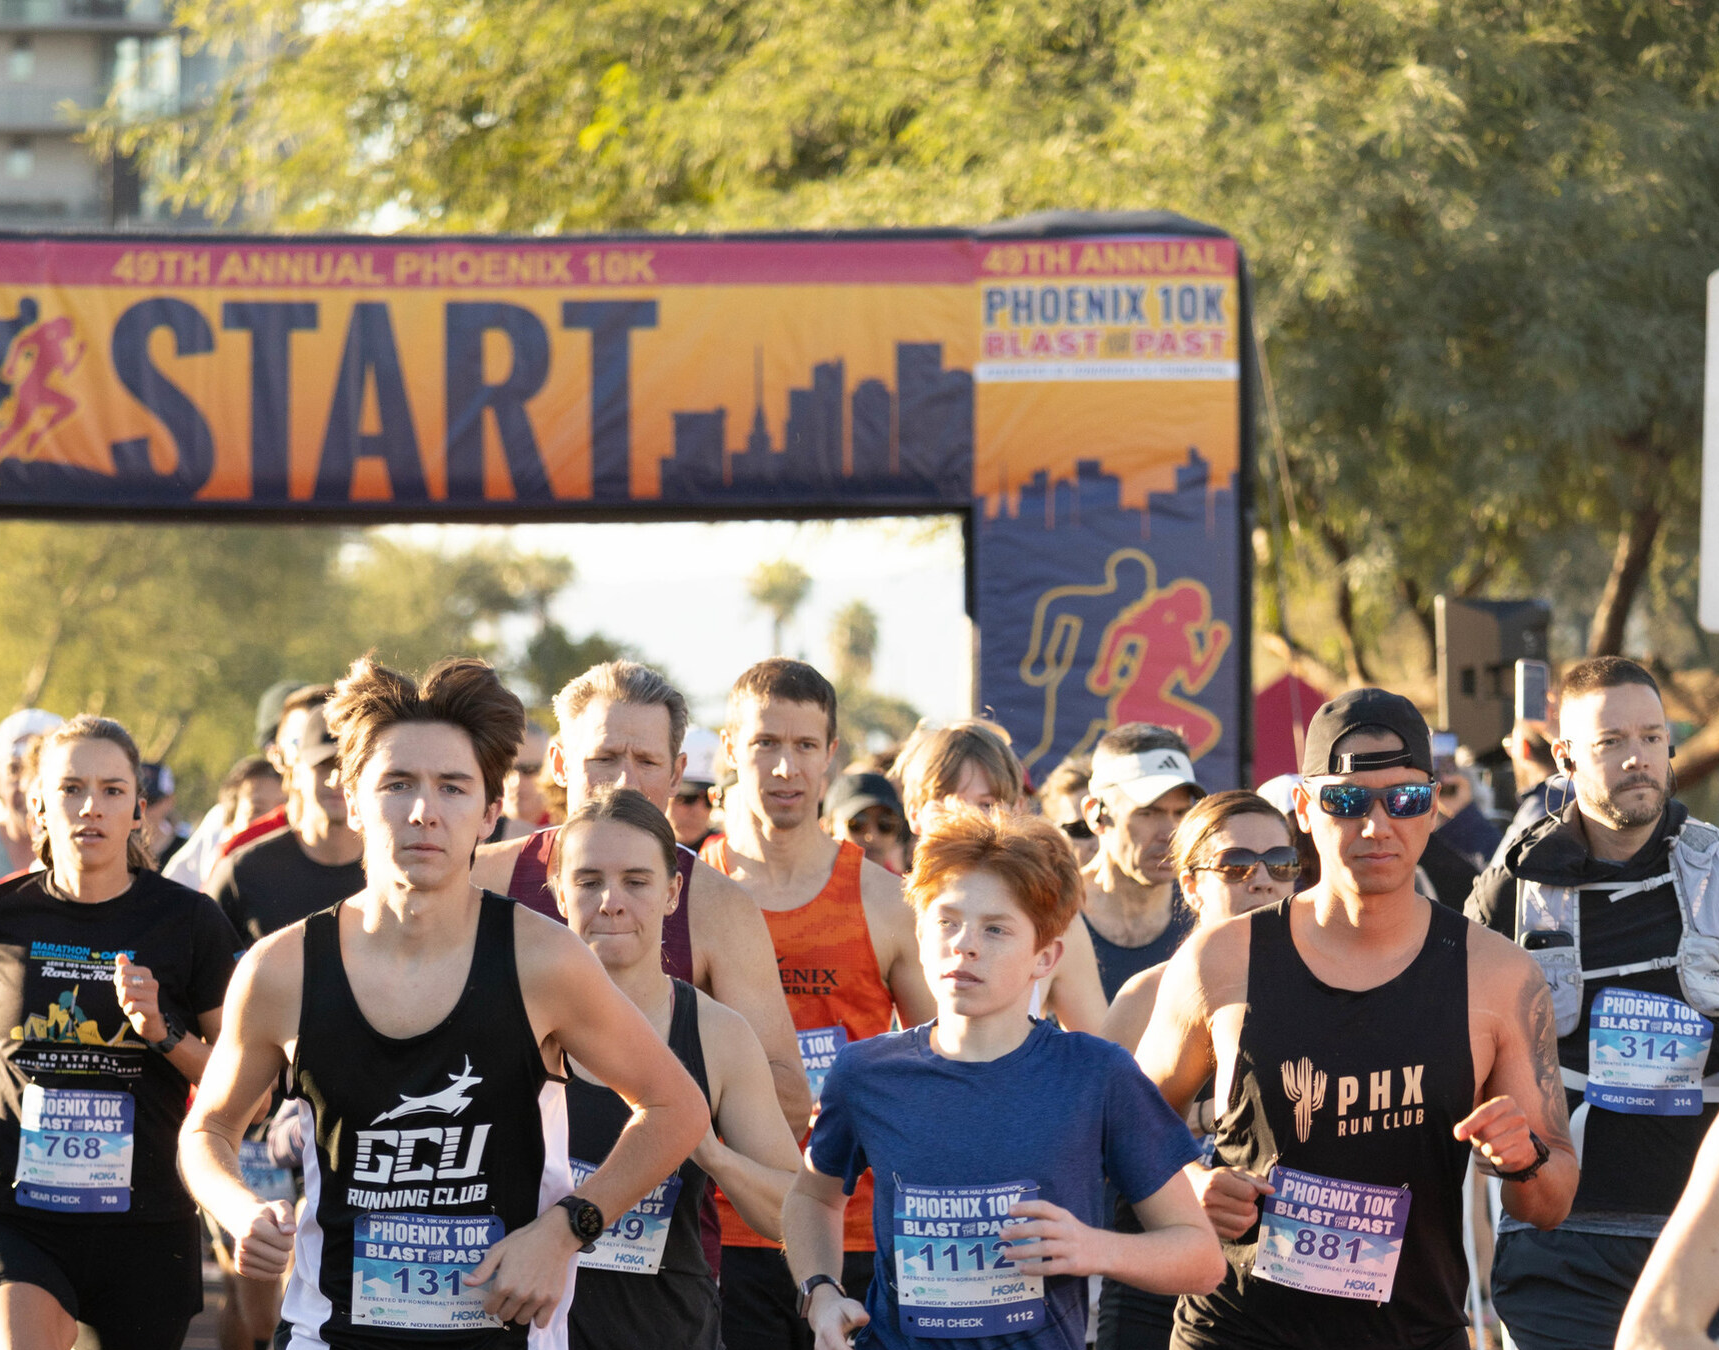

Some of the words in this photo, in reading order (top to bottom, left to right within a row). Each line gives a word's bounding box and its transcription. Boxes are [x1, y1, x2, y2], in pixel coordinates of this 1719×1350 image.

[111, 250, 211, 284] 49TH
[218, 251, 386, 284] ANNUAL
[394, 252, 573, 284] PHOENIX
[585, 251, 657, 283] 10K
[982, 245, 1072, 272] 49TH
[1078, 244, 1225, 271] ANNUAL
[984, 285, 1146, 326] PHOENIX
[1158, 285, 1226, 324] 10K
[986, 331, 1099, 358] BLAST
[1135, 330, 1228, 357] PAST
[111, 297, 659, 501] START
[32, 941, 90, 956] MARATHON
[42, 966, 80, 979] Rock
[93, 970, 115, 981] Ro
[1602, 996, 1669, 1019] PHOENIX
[1599, 1016, 1650, 1032] BLAST
[1662, 1021, 1704, 1037] PAST
[806, 1036, 837, 1055] 10K
[1619, 1035, 1679, 1063] 314
[1337, 1064, 1425, 1117] PHX
[1601, 1092, 1625, 1105] GEAR
[1626, 1095, 1656, 1107] CHECK
[42, 1098, 90, 1118] OENIX
[93, 1099, 123, 1118] 10K
[1674, 1098, 1692, 1107] 314
[84, 1118, 125, 1132] PAST
[1337, 1115, 1373, 1137] RUN
[1383, 1108, 1425, 1130] CLUB
[43, 1135, 102, 1160] 768
[353, 1123, 493, 1184] GCU
[51, 1194, 81, 1205] CHECK
[100, 1195, 118, 1204] 768
[346, 1188, 430, 1210] RUNNING
[432, 1183, 488, 1206] CLUB
[905, 1195, 983, 1219] PHOENIX
[1281, 1178, 1361, 1213] PHOENIX
[1363, 1194, 1397, 1218] 10K
[903, 1220, 961, 1237] BLAST
[1274, 1200, 1335, 1226] BLAST
[1347, 1216, 1396, 1235] PAST
[369, 1220, 450, 1246] PHOENIX
[454, 1225, 490, 1247] 10K
[365, 1242, 427, 1262] BLAST
[919, 1240, 1016, 1271] 1112
[1294, 1228, 1362, 1265] 881
[614, 1252, 645, 1266] HOKA
[393, 1267, 460, 1297] 131
[991, 1281, 1026, 1297] HOKA
[1343, 1278, 1376, 1293] HOKA
[450, 1310, 486, 1321] HOKA
[917, 1317, 945, 1328] GEAR
[946, 1317, 984, 1328] CHECK
[1006, 1310, 1034, 1323] 1112
